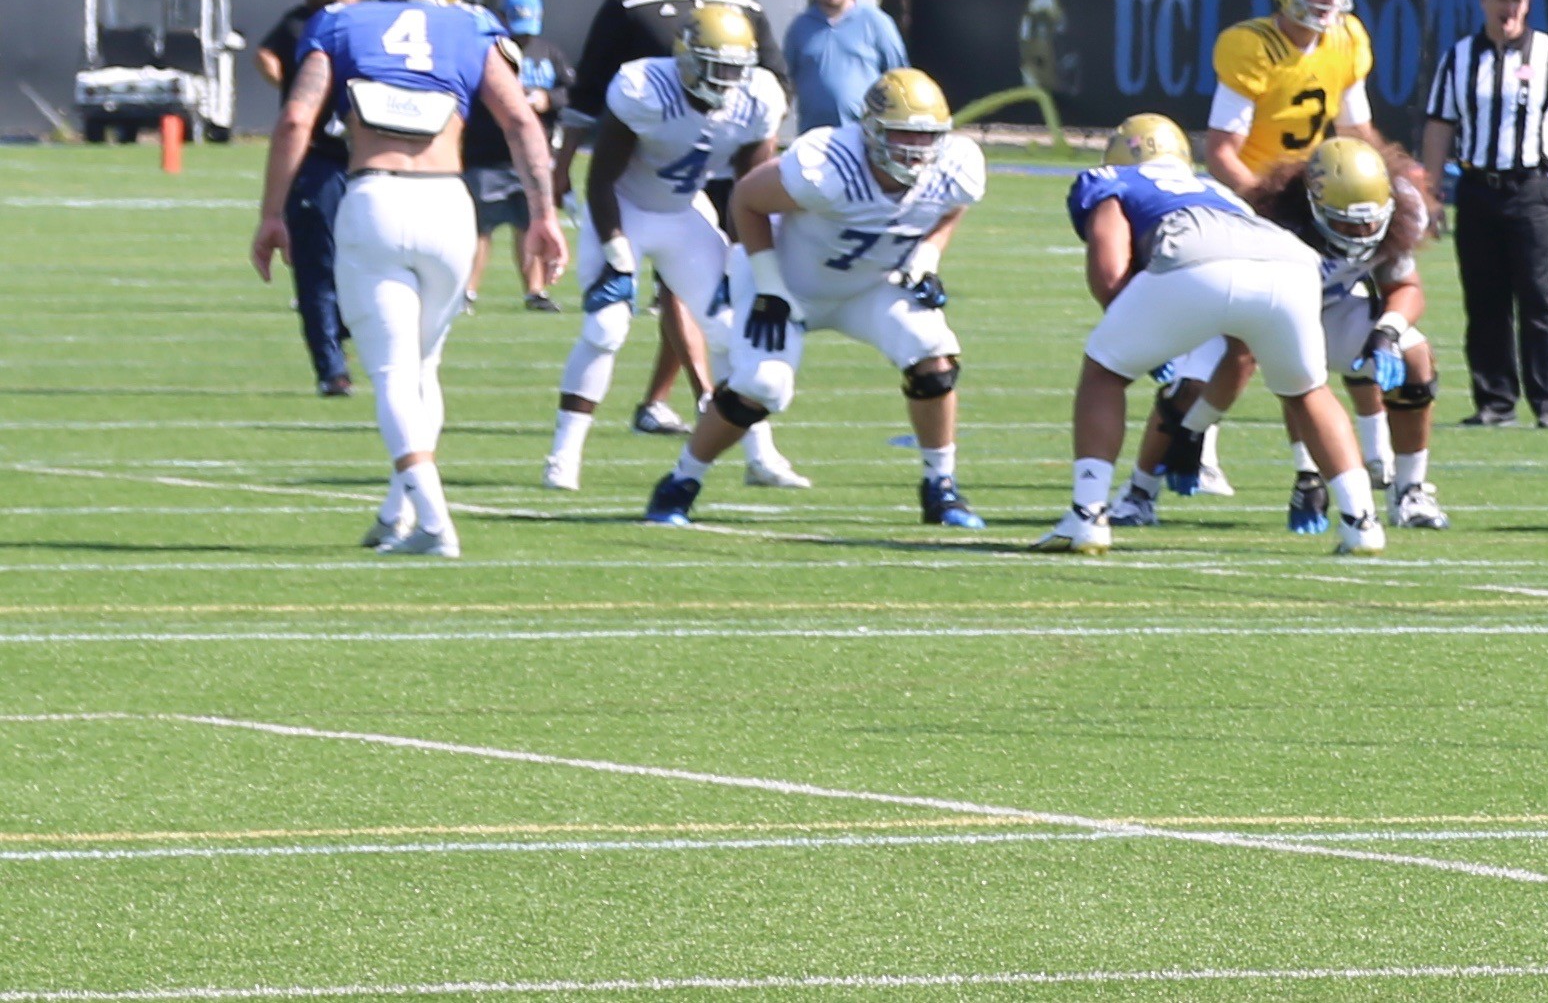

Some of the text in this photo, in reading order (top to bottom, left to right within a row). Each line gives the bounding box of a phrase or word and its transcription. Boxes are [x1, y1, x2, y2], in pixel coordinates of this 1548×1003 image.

[381, 8, 434, 71] 4
[1281, 88, 1326, 150] 3
[656, 148, 713, 194] 4
[825, 228, 924, 272] 77
